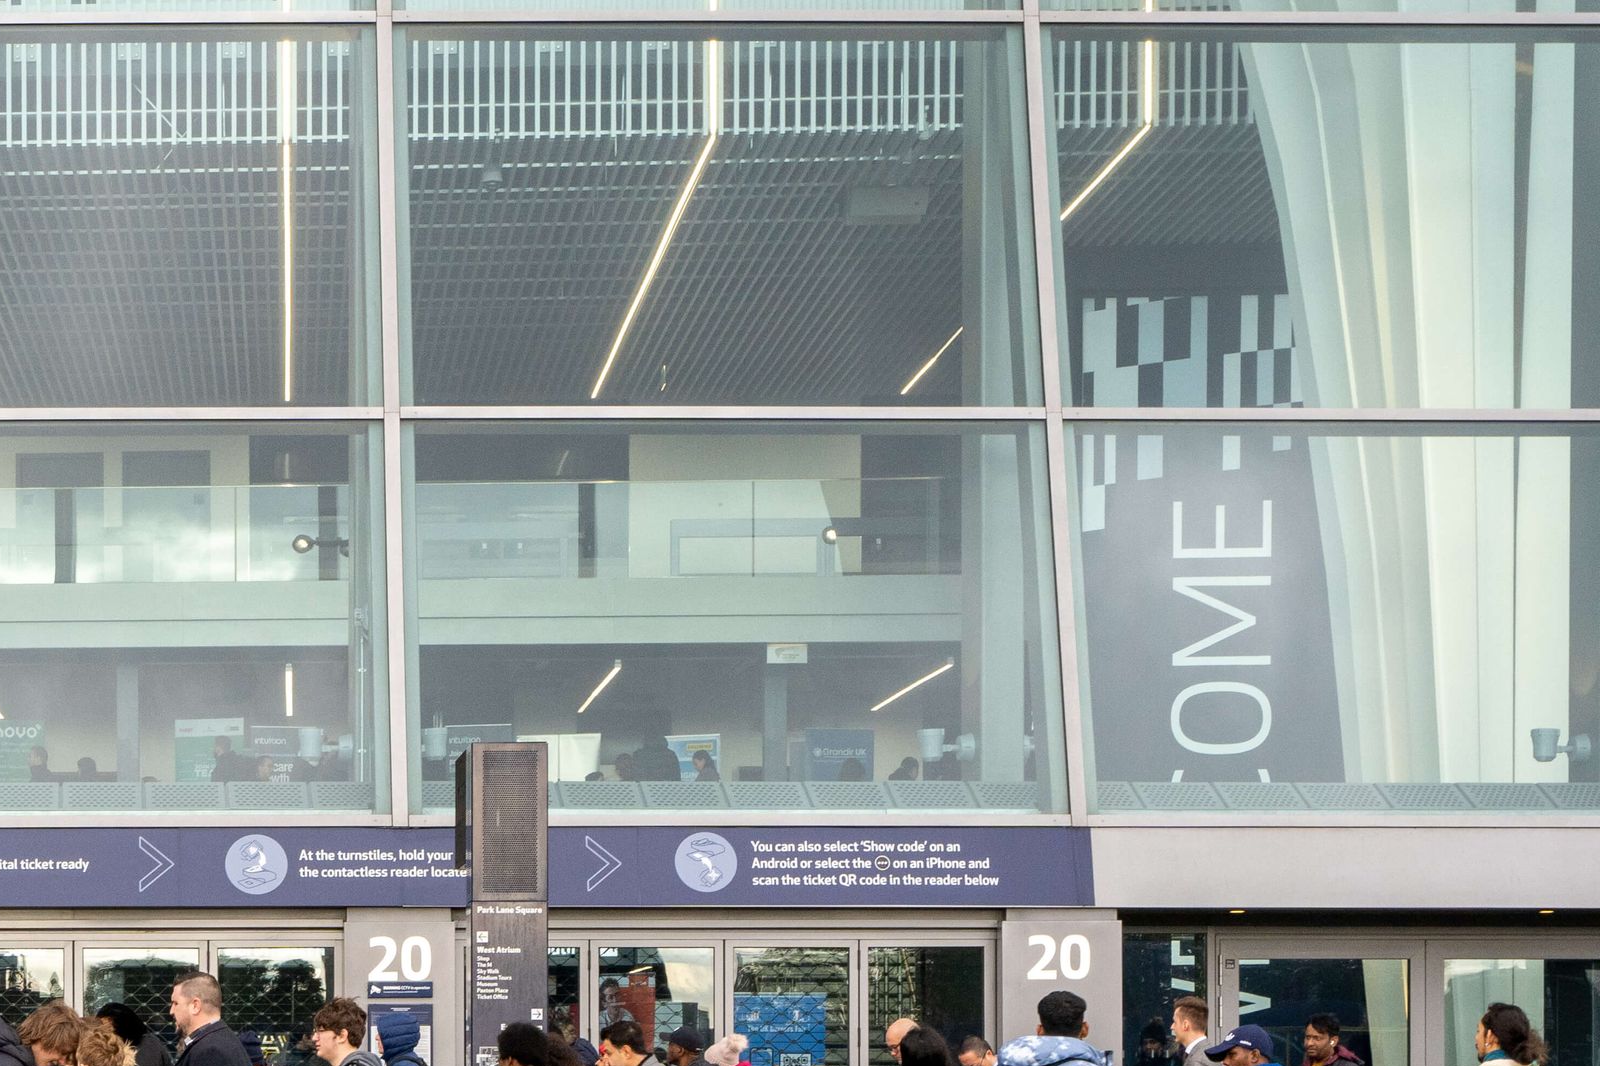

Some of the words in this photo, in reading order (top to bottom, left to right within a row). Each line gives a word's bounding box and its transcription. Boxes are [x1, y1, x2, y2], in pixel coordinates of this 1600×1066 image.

[1170, 500, 1273, 783] OME
[751, 841, 773, 852] You
[774, 843, 795, 852] can
[797, 841, 821, 852] also
[823, 841, 858, 852] select
[929, 843, 944, 852] on
[946, 843, 960, 852] an
[299, 850, 313, 861] At
[315, 850, 335, 861] the
[337, 850, 397, 862] turnstiles,
[399, 850, 425, 861] hold
[427, 852, 454, 863] your
[752, 858, 798, 869] Android
[800, 860, 813, 868] or
[815, 858, 850, 869] select
[852, 858, 871, 868] the
[893, 860, 908, 868] on
[910, 860, 924, 868] an
[926, 857, 966, 868] iPhone
[968, 857, 990, 868] and
[20, 859, 54, 870] ticket
[56, 859, 89, 872] ready
[299, 867, 319, 878] the
[321, 867, 388, 878] contactless
[390, 867, 429, 877] reader
[431, 866, 468, 877] locate
[752, 876, 779, 886] scan
[781, 874, 800, 885] the
[803, 874, 837, 885] ticket
[839, 874, 857, 887] QR
[859, 874, 887, 885] code
[889, 874, 901, 885] in
[902, 874, 922, 885] the
[924, 874, 963, 885] reader
[964, 874, 999, 885] below
[476, 906, 495, 914] Park
[496, 906, 514, 914] Lane
[515, 906, 543, 916] Square
[476, 946, 495, 954] West
[496, 946, 521, 954] Atrium
[368, 936, 432, 982] 20
[1027, 934, 1091, 980] 20
